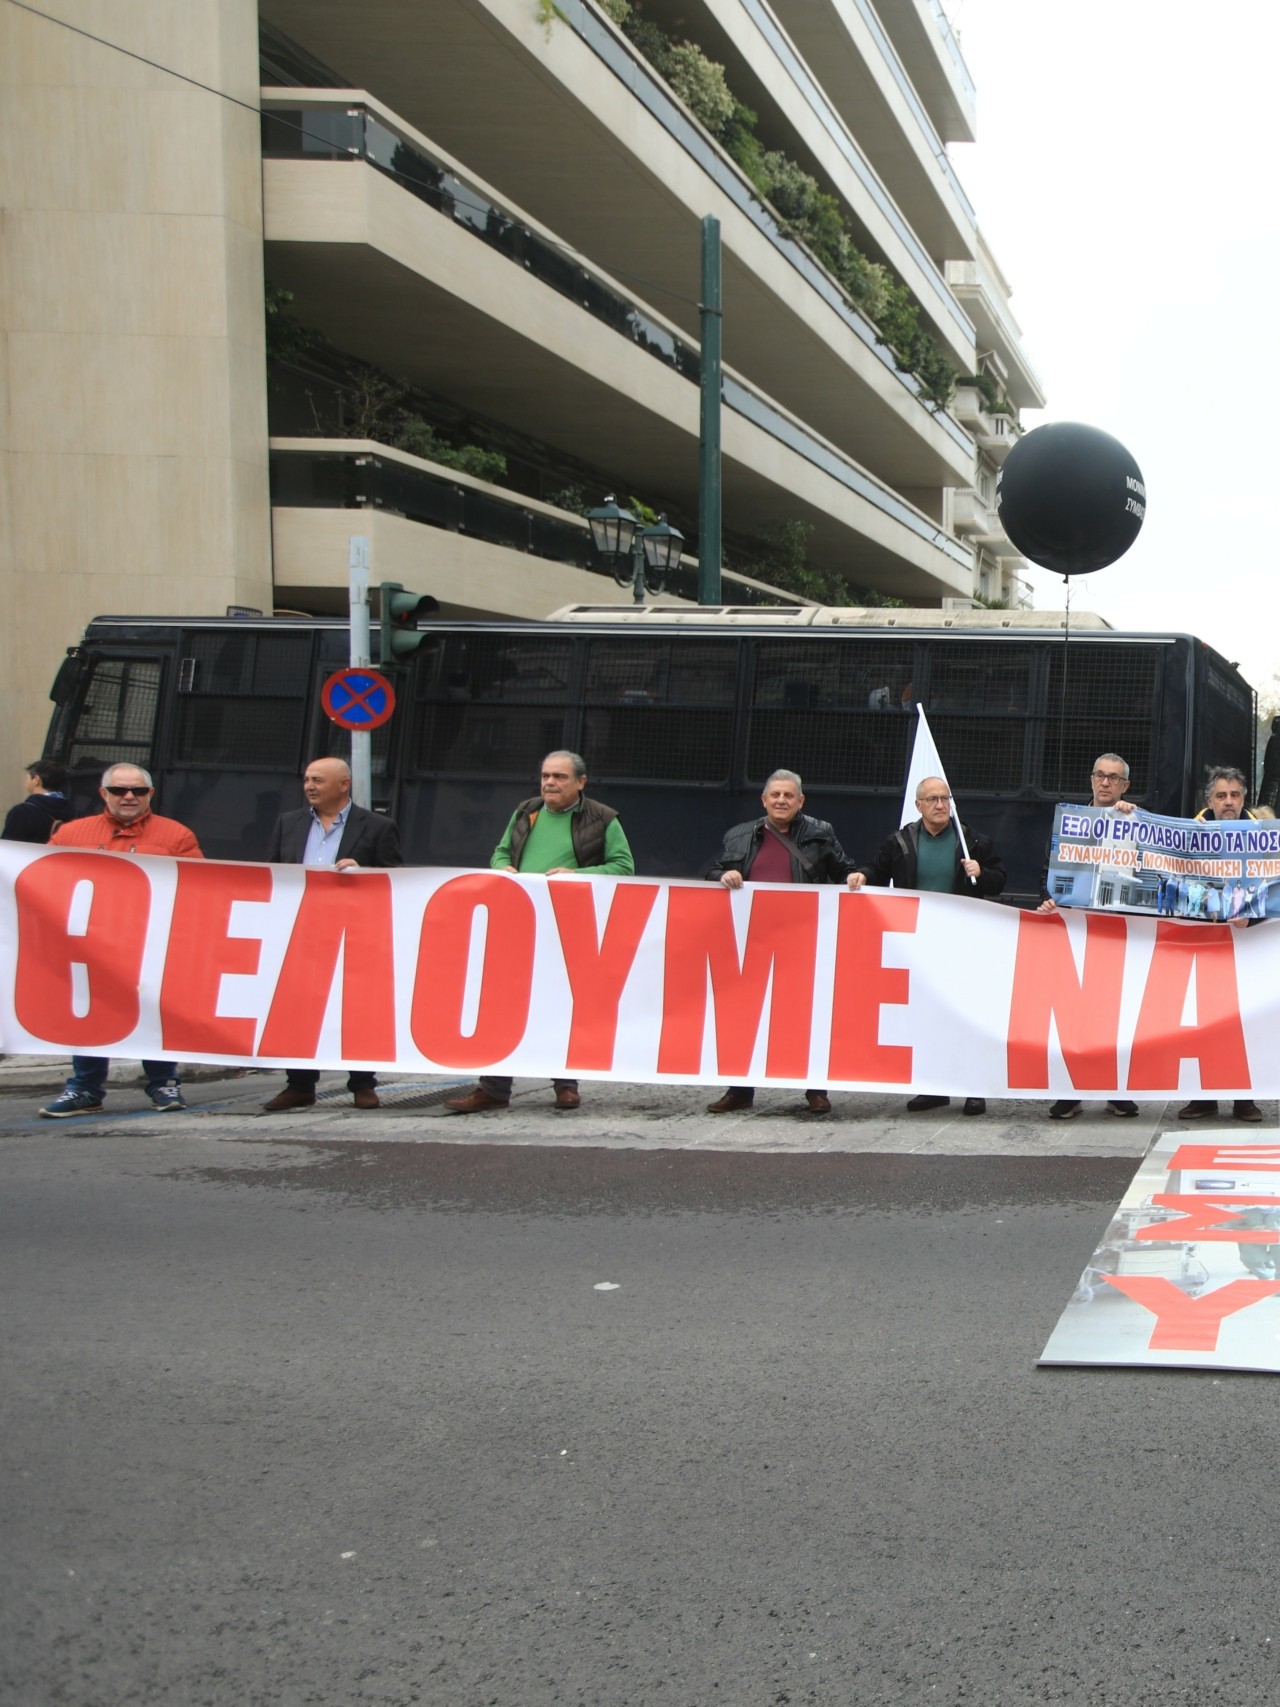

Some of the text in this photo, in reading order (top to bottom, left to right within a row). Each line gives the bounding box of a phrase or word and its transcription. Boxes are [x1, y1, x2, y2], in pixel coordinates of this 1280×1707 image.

[1061, 815, 1090, 837] ΕΞΩ
[1094, 819, 1110, 839] ΟΙ
[1112, 820, 1186, 851] ΕΡΓΟΛΑΒΟΙ
[1189, 832, 1222, 852] ΑΠΟ
[1225, 832, 1244, 852] ΤΑ
[1059, 844, 1111, 864] ΣΥΝΑΨΗ
[1113, 849, 1142, 871] ΣΟΧ,
[1143, 853, 1241, 876] ΜΟΝΙΜΟΠΟΙΗΣΗ
[14, 851, 920, 1084] ΘΕΛΟΥΜΕ
[1007, 911, 1252, 1091] ΝΑ
